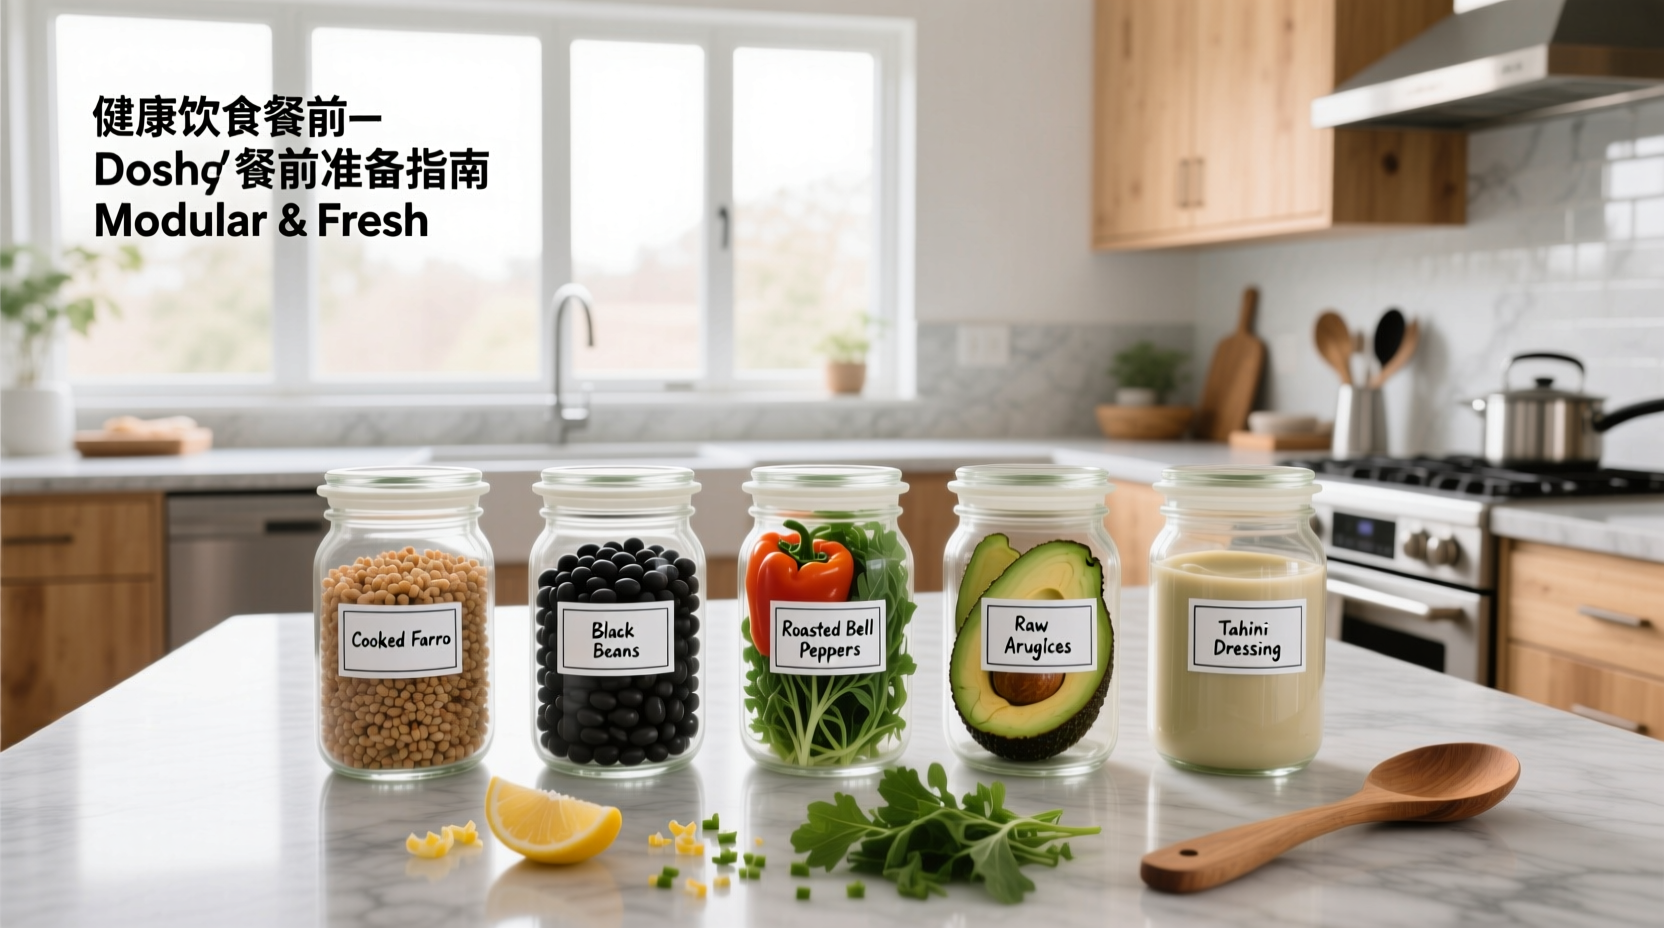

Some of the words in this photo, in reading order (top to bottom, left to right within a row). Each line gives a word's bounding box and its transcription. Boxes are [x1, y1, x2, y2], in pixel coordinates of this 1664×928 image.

[592, 621, 634, 640] Black
[782, 619, 841, 638] Roasted
[846, 618, 874, 637] Bell
[1015, 614, 1049, 633] Raw
[1218, 619, 1269, 636] Tahini
[351, 630, 406, 649] Cooked
[411, 629, 451, 648] Farro
[593, 642, 640, 659] Beans
[800, 641, 861, 664] Peppers
[1213, 638, 1281, 663] Dressing
